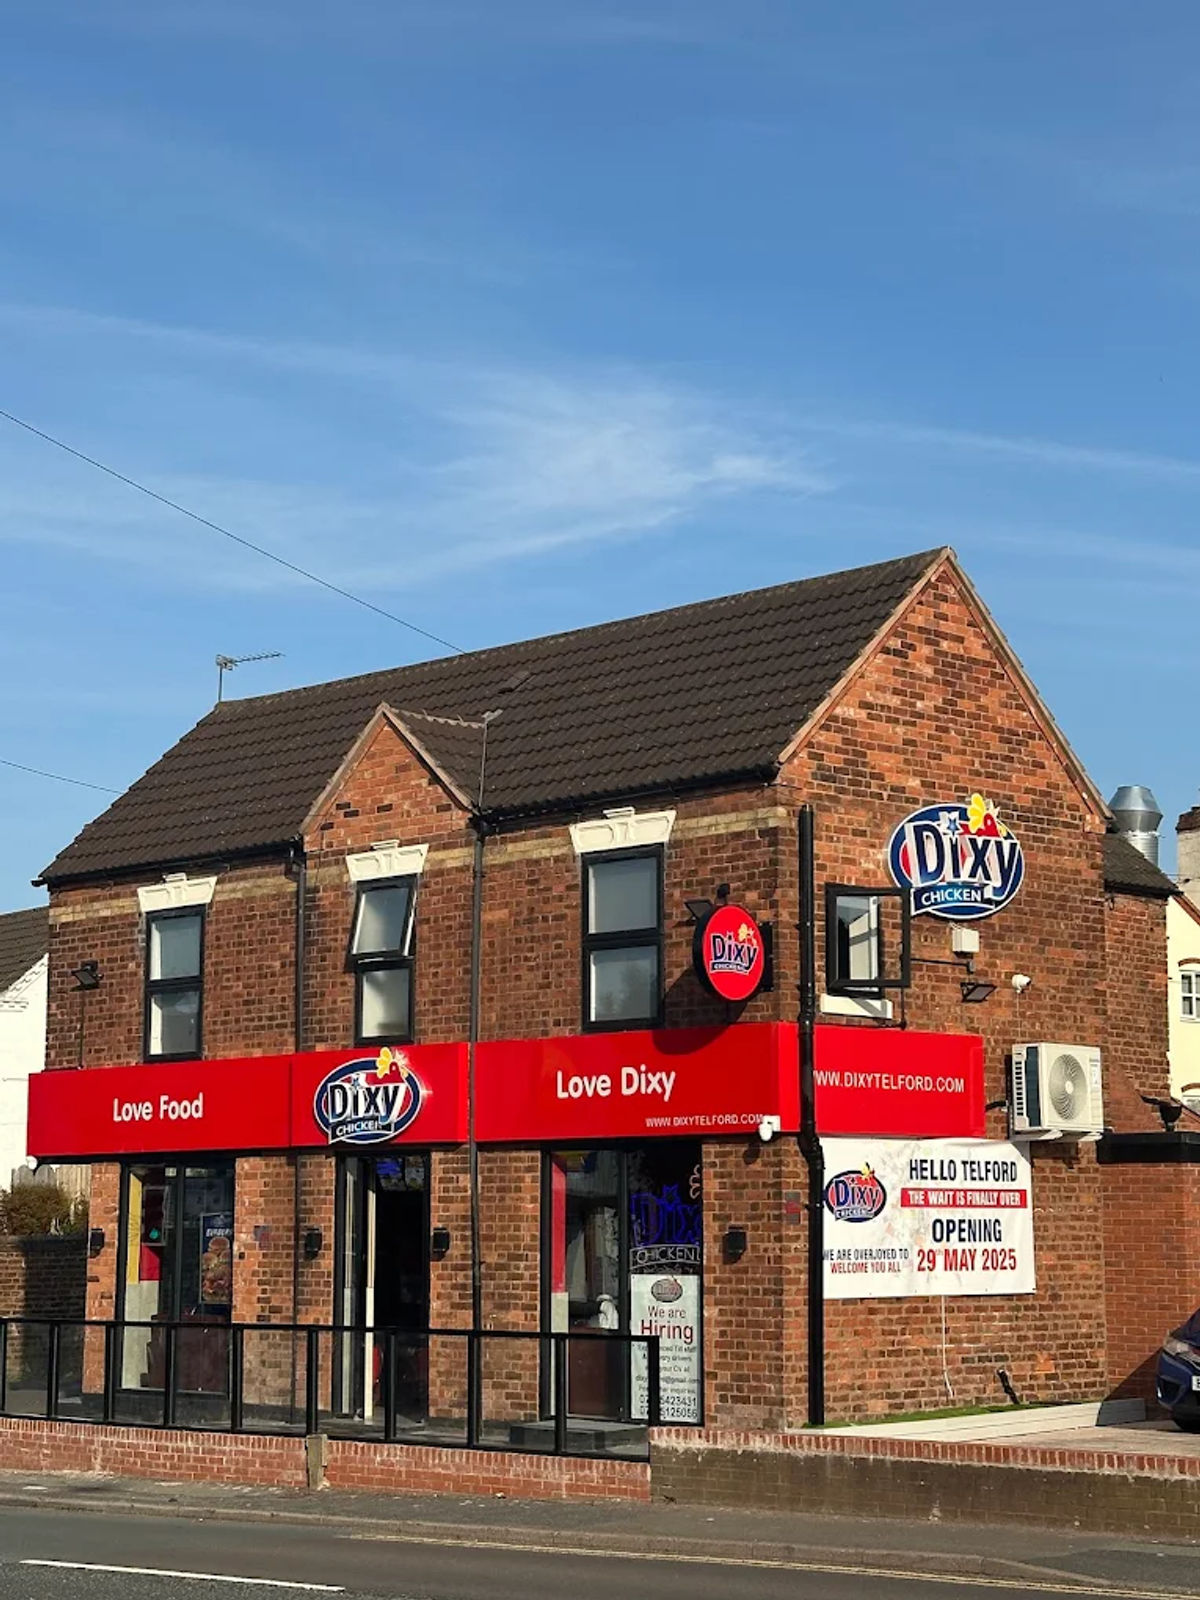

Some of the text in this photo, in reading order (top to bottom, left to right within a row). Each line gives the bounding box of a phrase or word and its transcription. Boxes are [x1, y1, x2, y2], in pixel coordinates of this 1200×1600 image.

[907, 813, 1019, 899] Dixy
[921, 888, 981, 905] CHICKEN
[710, 932, 758, 970] Dixy
[556, 1064, 676, 1102] Love Dixy
[813, 1070, 965, 1093] WW.DIXYTELFORD.COM
[113, 1092, 203, 1122] Love Food
[329, 1077, 402, 1123] Dixy
[909, 1159, 1018, 1182] HELLO TELFORD
[908, 1190, 1021, 1206] THE WAIT IS FINALLY OVER
[932, 1218, 1002, 1243] OPENING
[637, 1247, 695, 1263] CHICKEN
[837, 1249, 851, 1260] ARE
[854, 1249, 897, 1260] OVERJOYED
[899, 1248, 909, 1260] TO
[944, 1248, 977, 1272] MAY
[982, 1248, 1017, 1271] 2025
[831, 1261, 901, 1274] WELCOME YOU ALL
[648, 1305, 686, 1319] We are
[641, 1319, 693, 1345] Hiring
